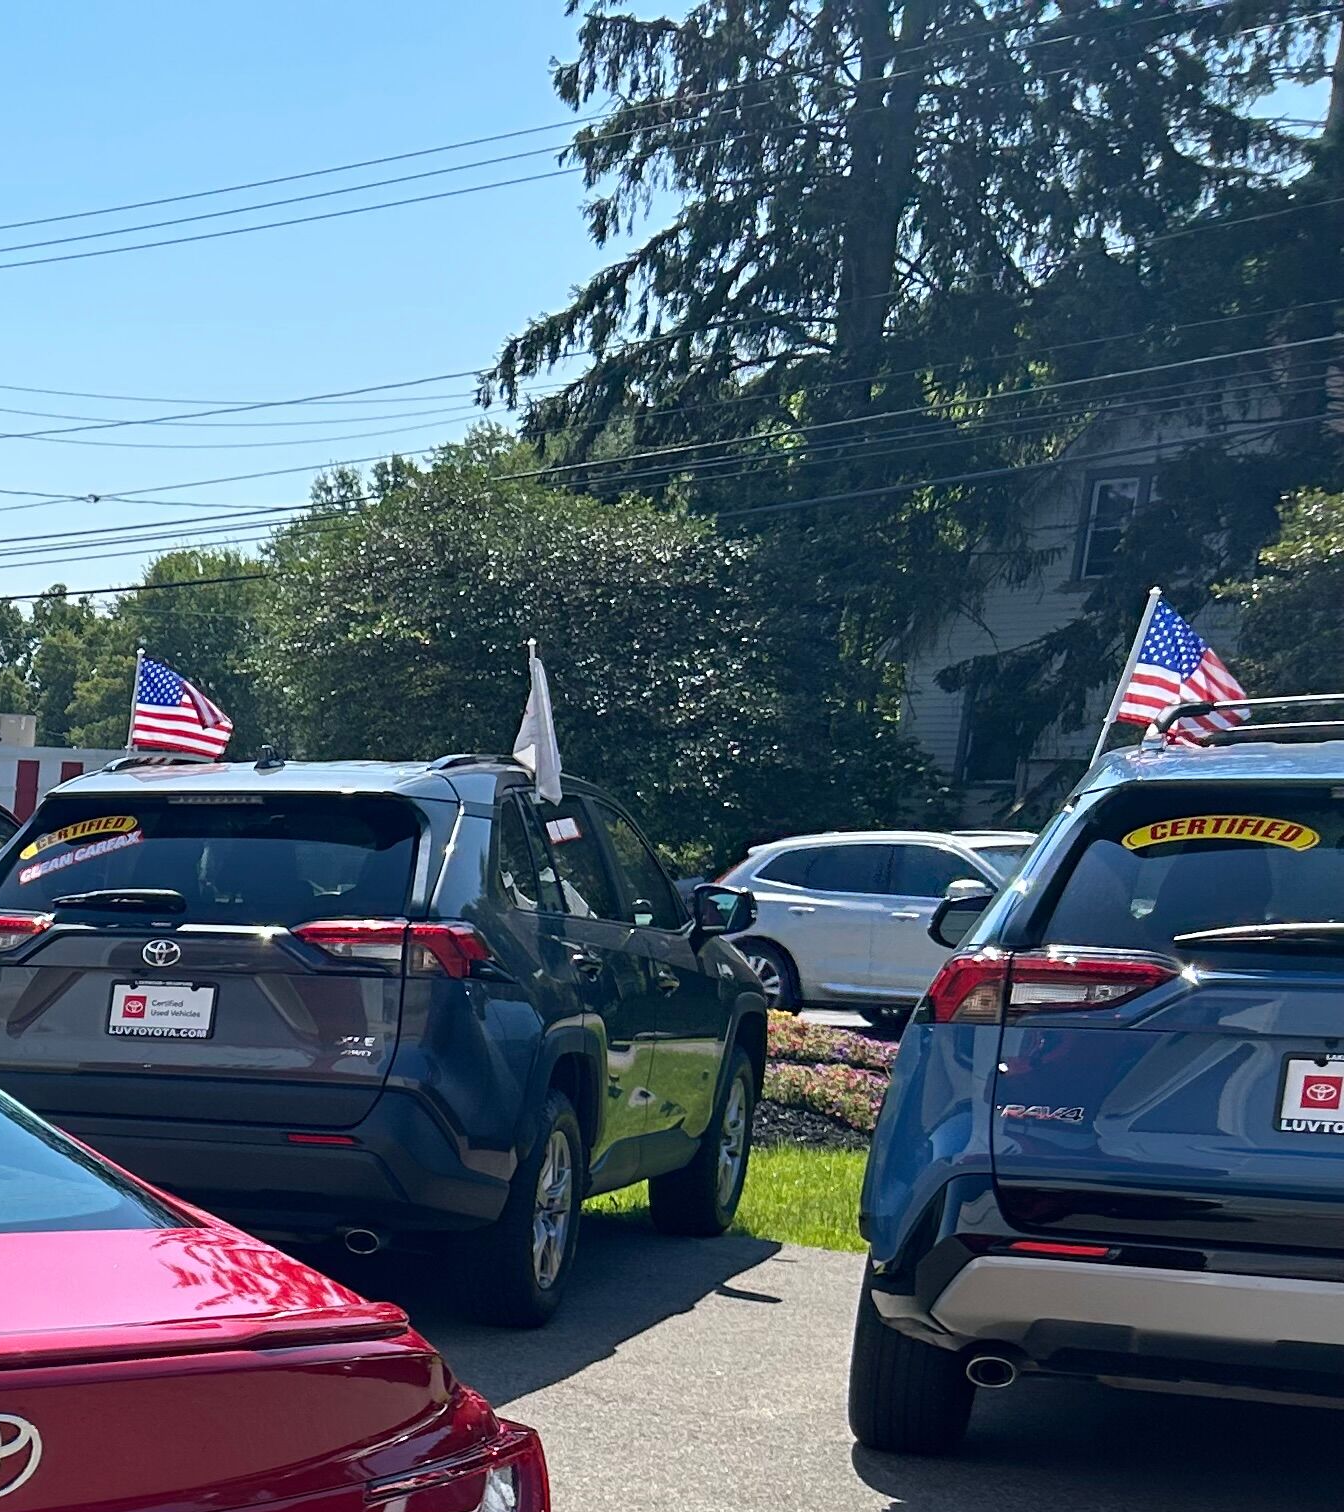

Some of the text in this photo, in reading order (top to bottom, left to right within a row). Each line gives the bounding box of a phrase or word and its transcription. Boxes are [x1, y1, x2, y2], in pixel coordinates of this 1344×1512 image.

[36, 817, 126, 849] CERTIFIED
[1150, 818, 1304, 842] CERTIFIED
[20, 829, 142, 884] CLEAN CARFAX
[108, 1025, 207, 1038] LUVTOYOTA.COM
[1001, 1104, 1085, 1123] RAV4
